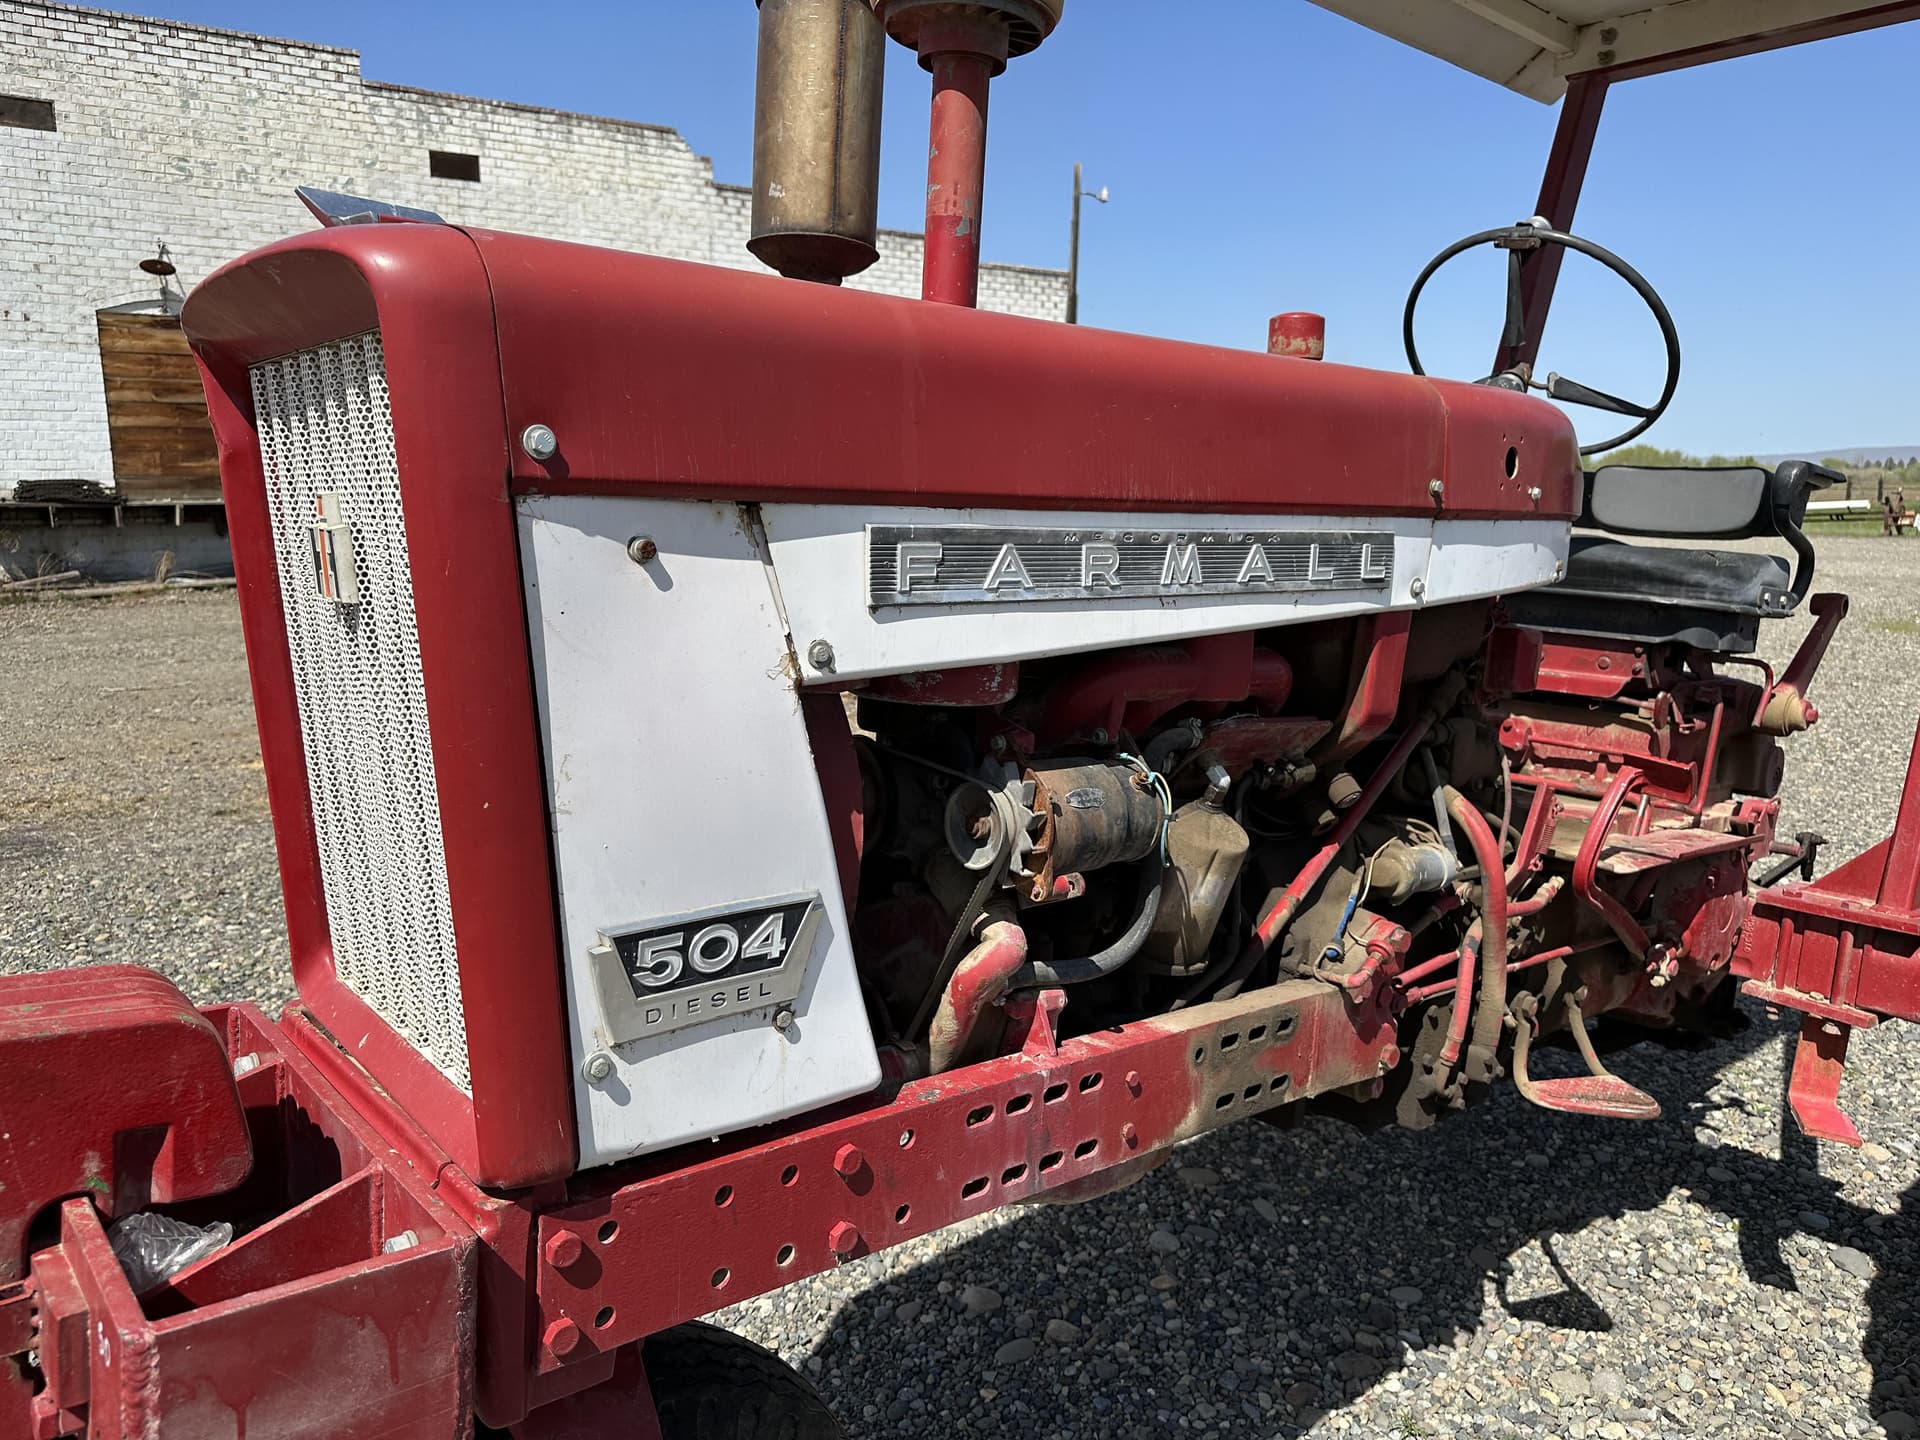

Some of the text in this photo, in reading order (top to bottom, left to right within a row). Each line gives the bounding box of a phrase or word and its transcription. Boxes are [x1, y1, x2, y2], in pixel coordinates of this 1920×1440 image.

[899, 543, 1387, 595] FARMALL
[632, 912, 787, 987] 504
[646, 982, 772, 1025] DIESEL
